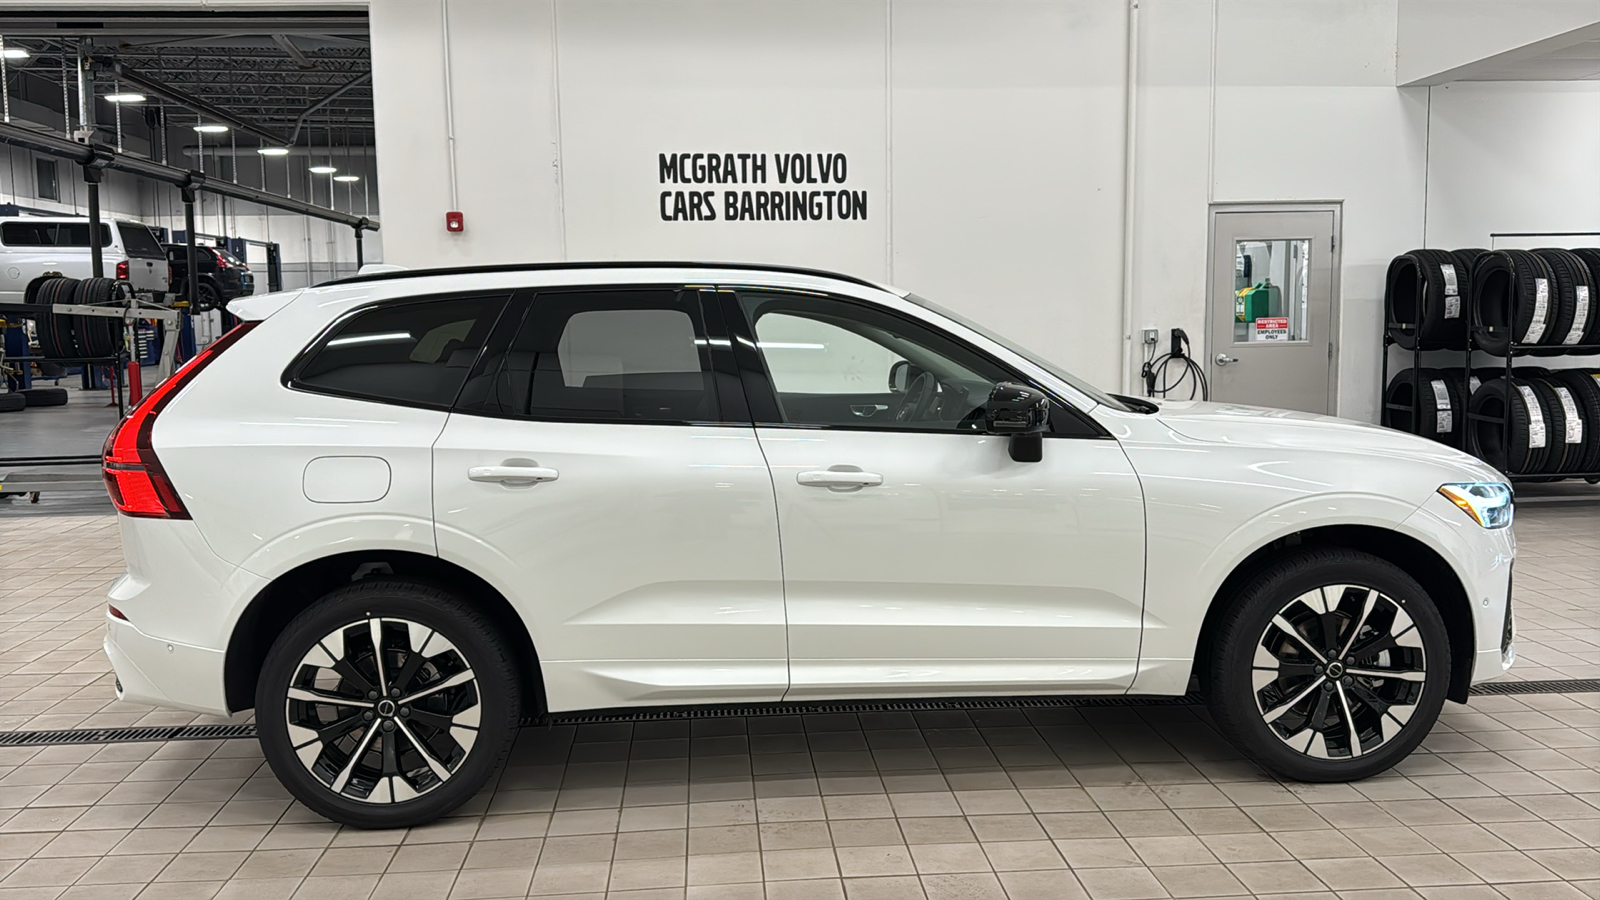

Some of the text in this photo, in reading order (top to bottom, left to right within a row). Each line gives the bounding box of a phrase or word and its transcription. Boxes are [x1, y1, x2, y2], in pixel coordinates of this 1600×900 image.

[658, 153, 847, 184] MCGRATH VOLVO
[660, 190, 867, 221] CARS BARRINGTON
